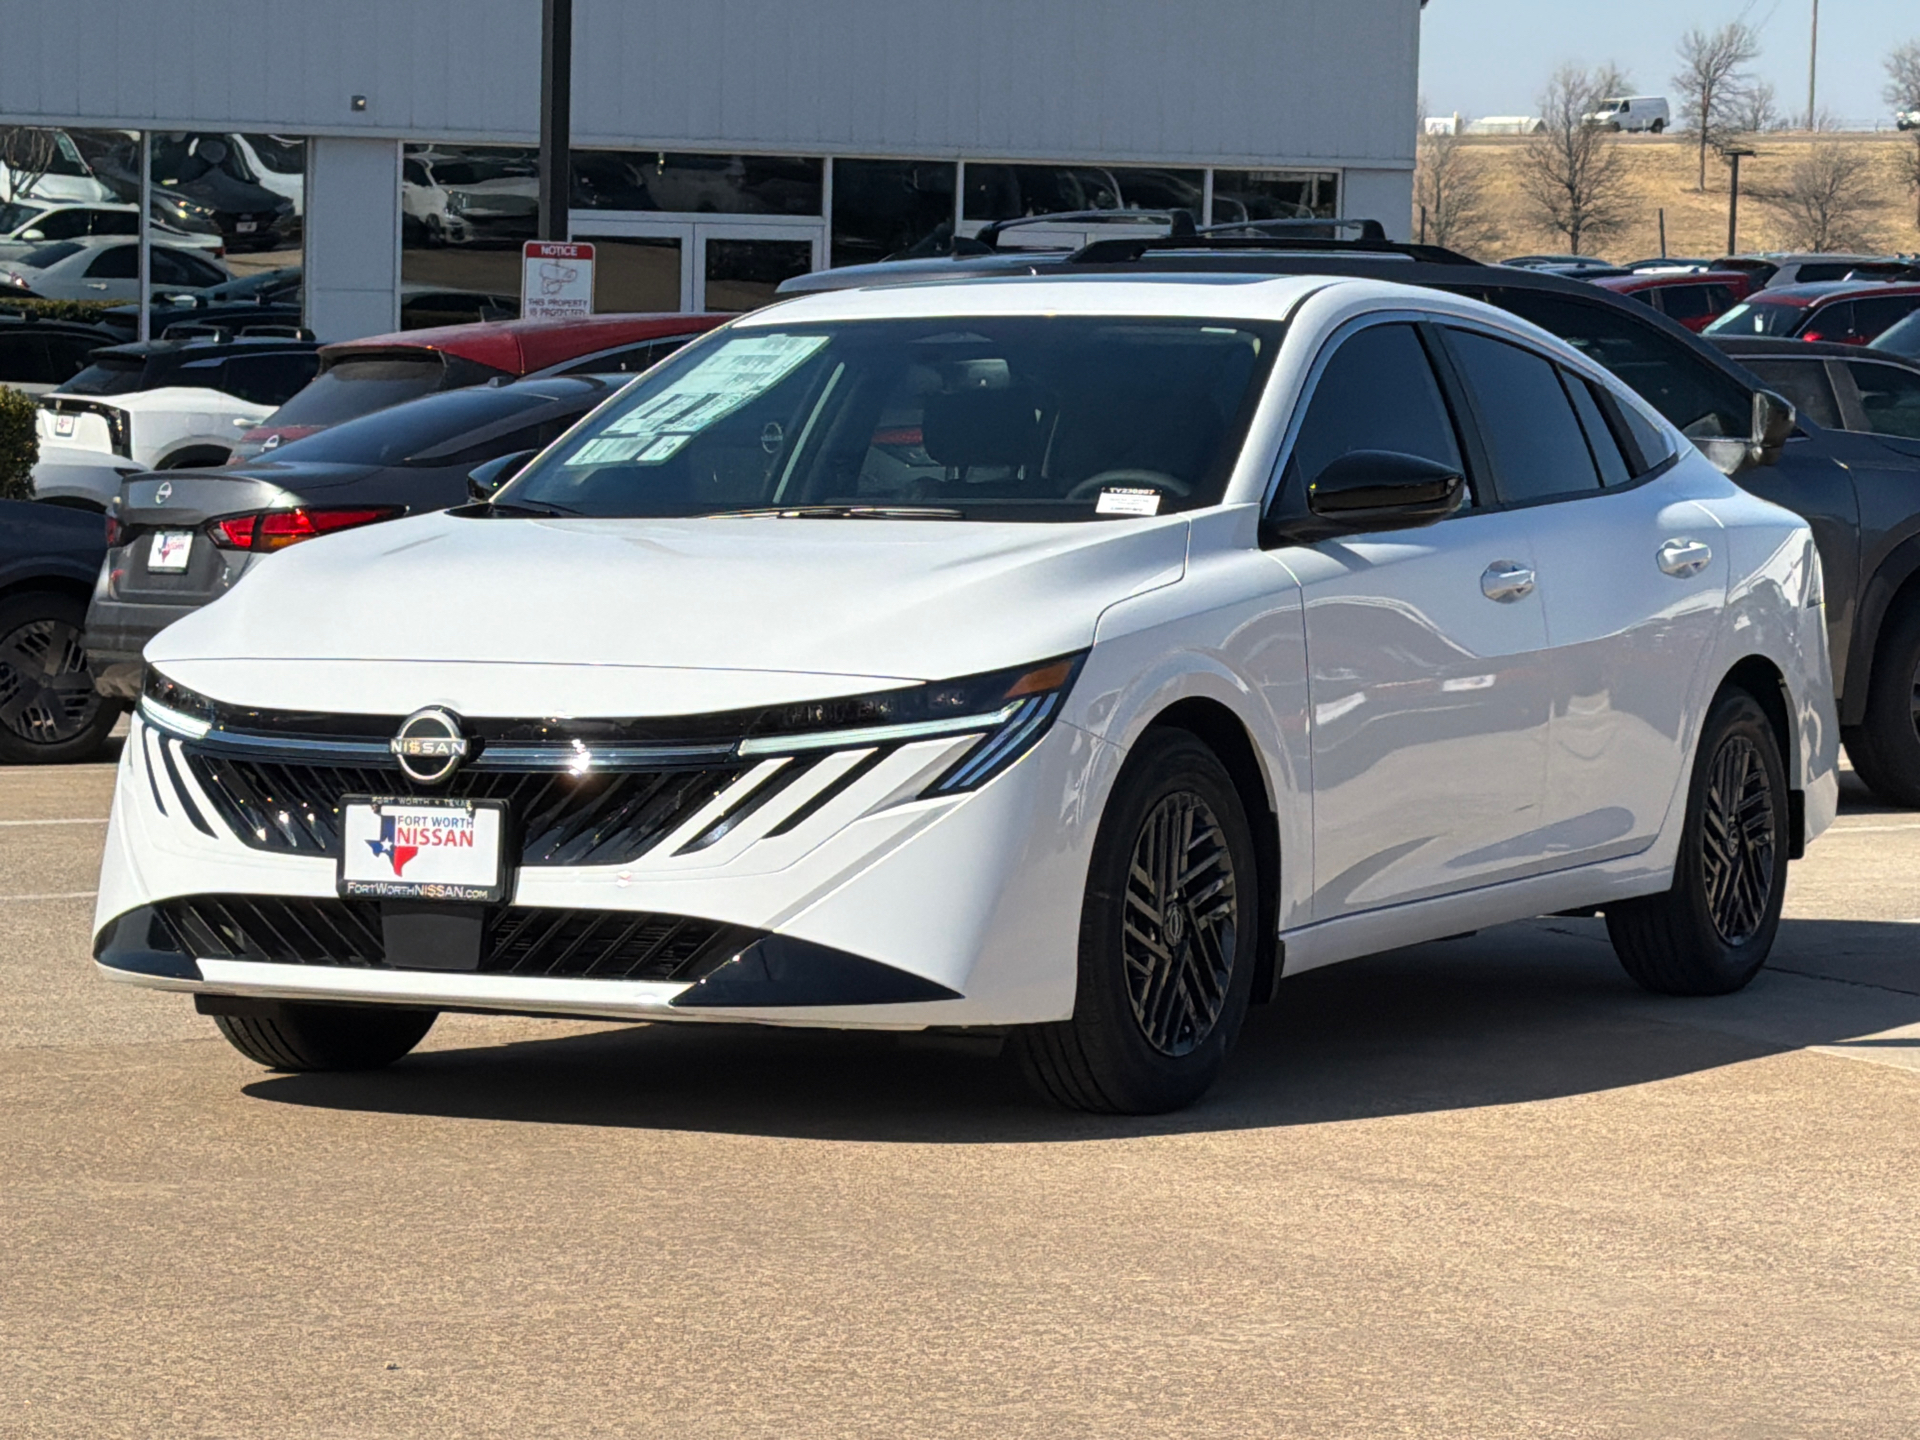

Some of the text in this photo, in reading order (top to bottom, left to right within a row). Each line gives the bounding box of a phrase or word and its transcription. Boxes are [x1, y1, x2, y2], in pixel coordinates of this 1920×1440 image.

[541, 246, 578, 256] NOTICE
[528, 298, 588, 308] THIS PROPERTY
[391, 740, 467, 755] NISSAN
[372, 796, 472, 808] FORT WORTH TEXAS
[397, 815, 474, 829] FORT WORTH
[397, 827, 474, 848] NISSAN
